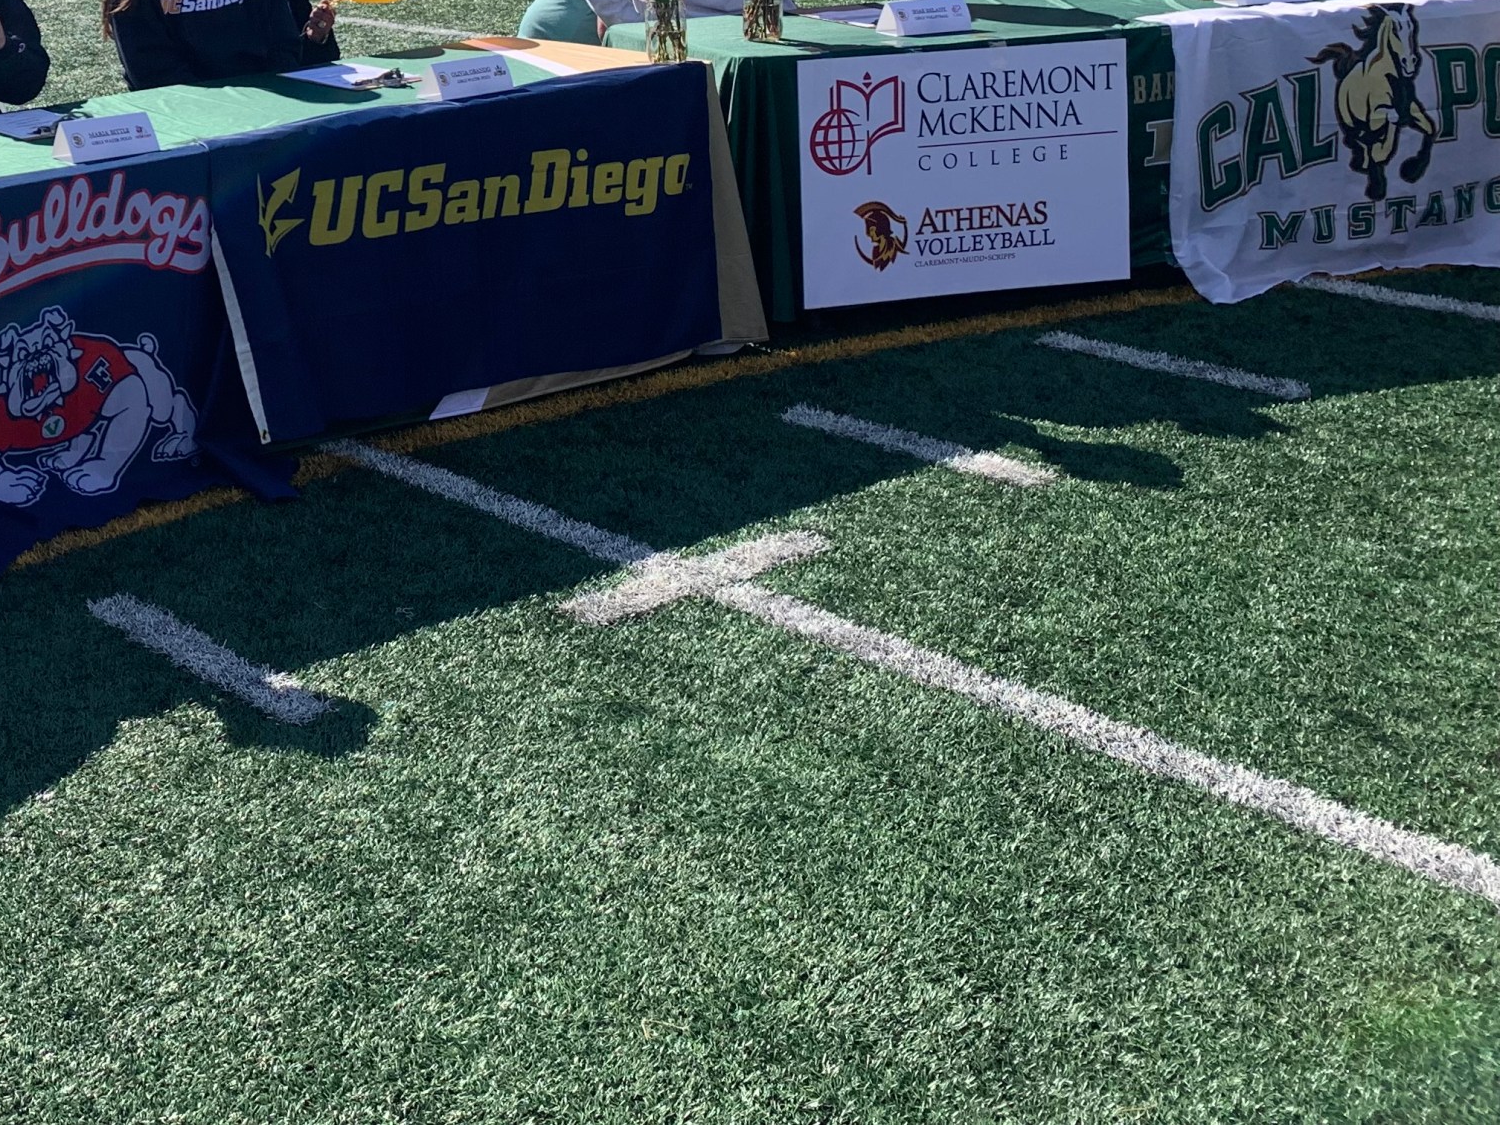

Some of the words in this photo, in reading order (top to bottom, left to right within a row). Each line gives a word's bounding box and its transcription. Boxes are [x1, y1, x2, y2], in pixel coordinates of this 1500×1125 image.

[917, 62, 1118, 104] CLAREMONT
[1197, 68, 1338, 211] CAL
[918, 144, 1068, 171] COLLEGE
[915, 200, 1048, 235] ATHENAS
[914, 228, 1055, 257] VOLLEYBALL
